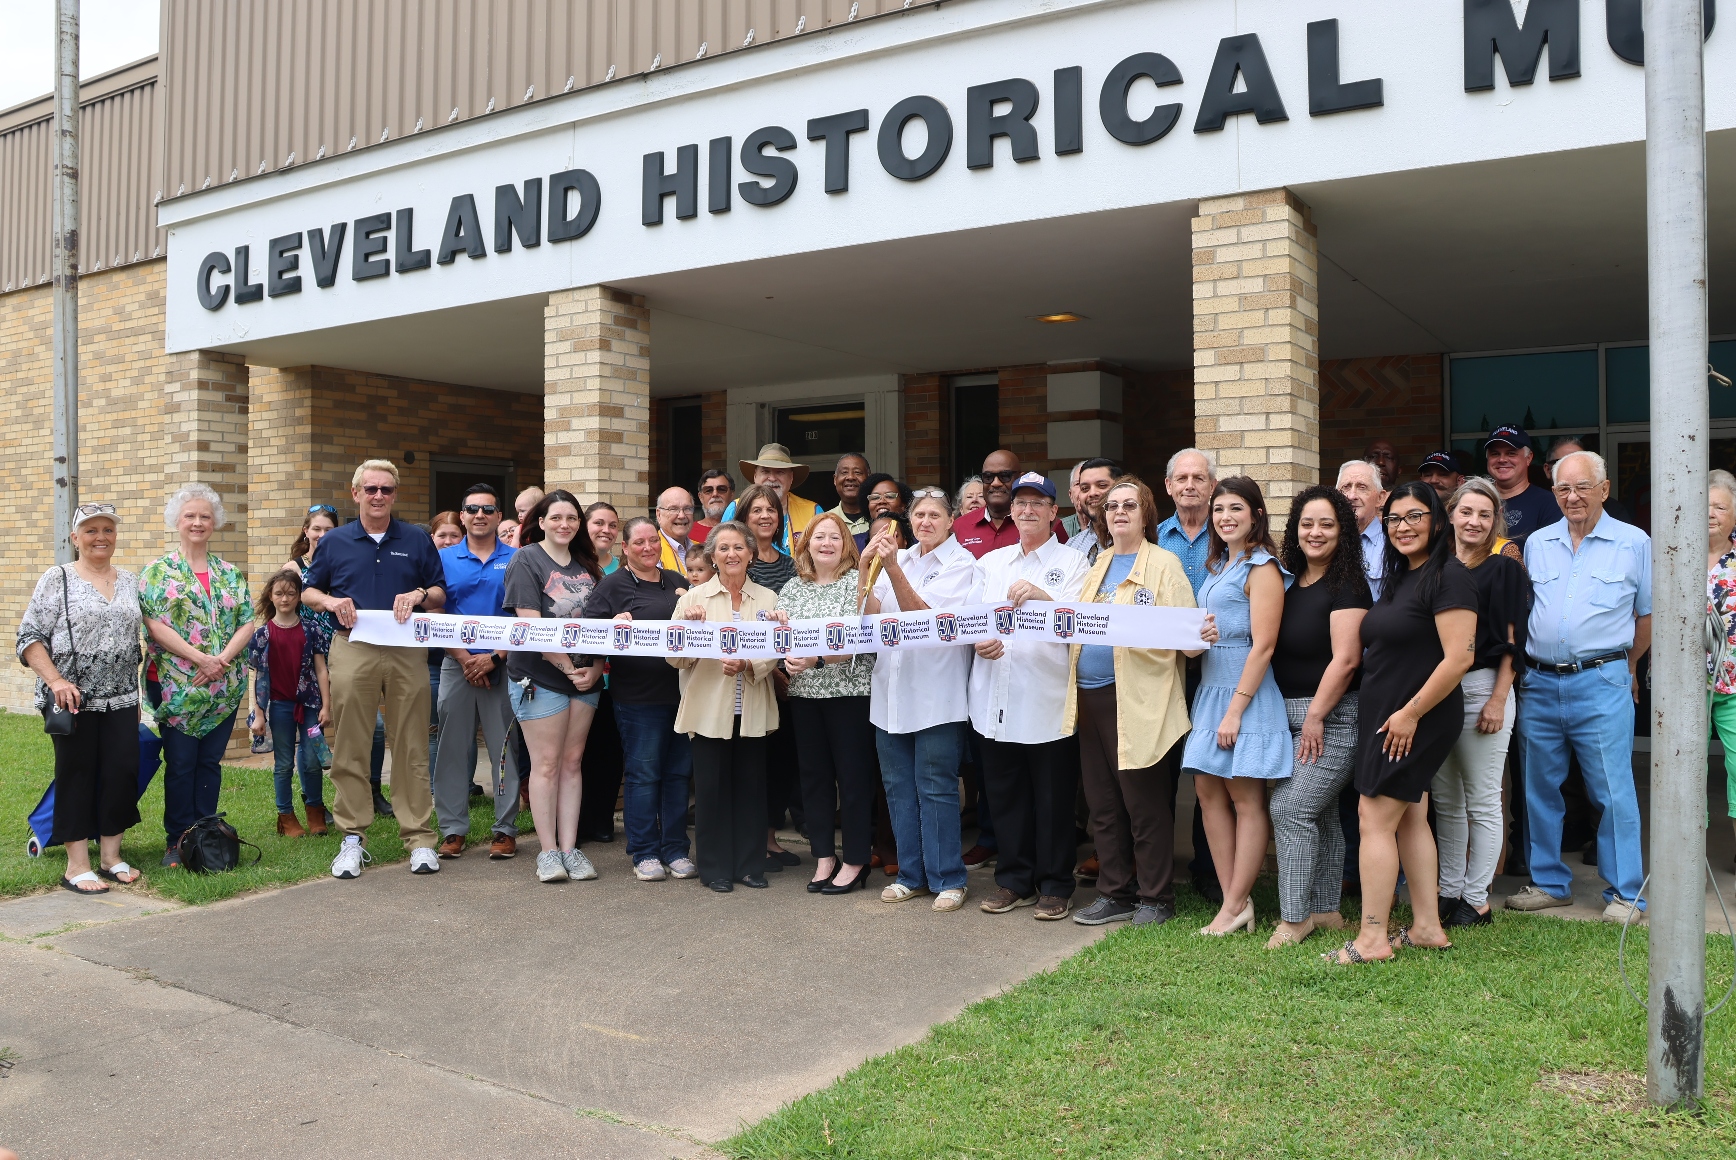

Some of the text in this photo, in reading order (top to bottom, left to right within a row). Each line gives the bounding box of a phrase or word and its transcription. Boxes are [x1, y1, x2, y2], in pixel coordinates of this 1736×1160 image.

[197, 168, 602, 312] CLEVELAND
[641, 18, 1384, 226] HISTORICAL
[956, 613, 988, 622] Cleveland
[1016, 609, 1046, 618] Cleveland
[1076, 613, 1109, 621] Cleveland
[900, 619, 930, 627] Cleveland
[959, 620, 988, 628] Historical
[1016, 616, 1046, 624] Historical
[845, 624, 874, 632] Clevland
